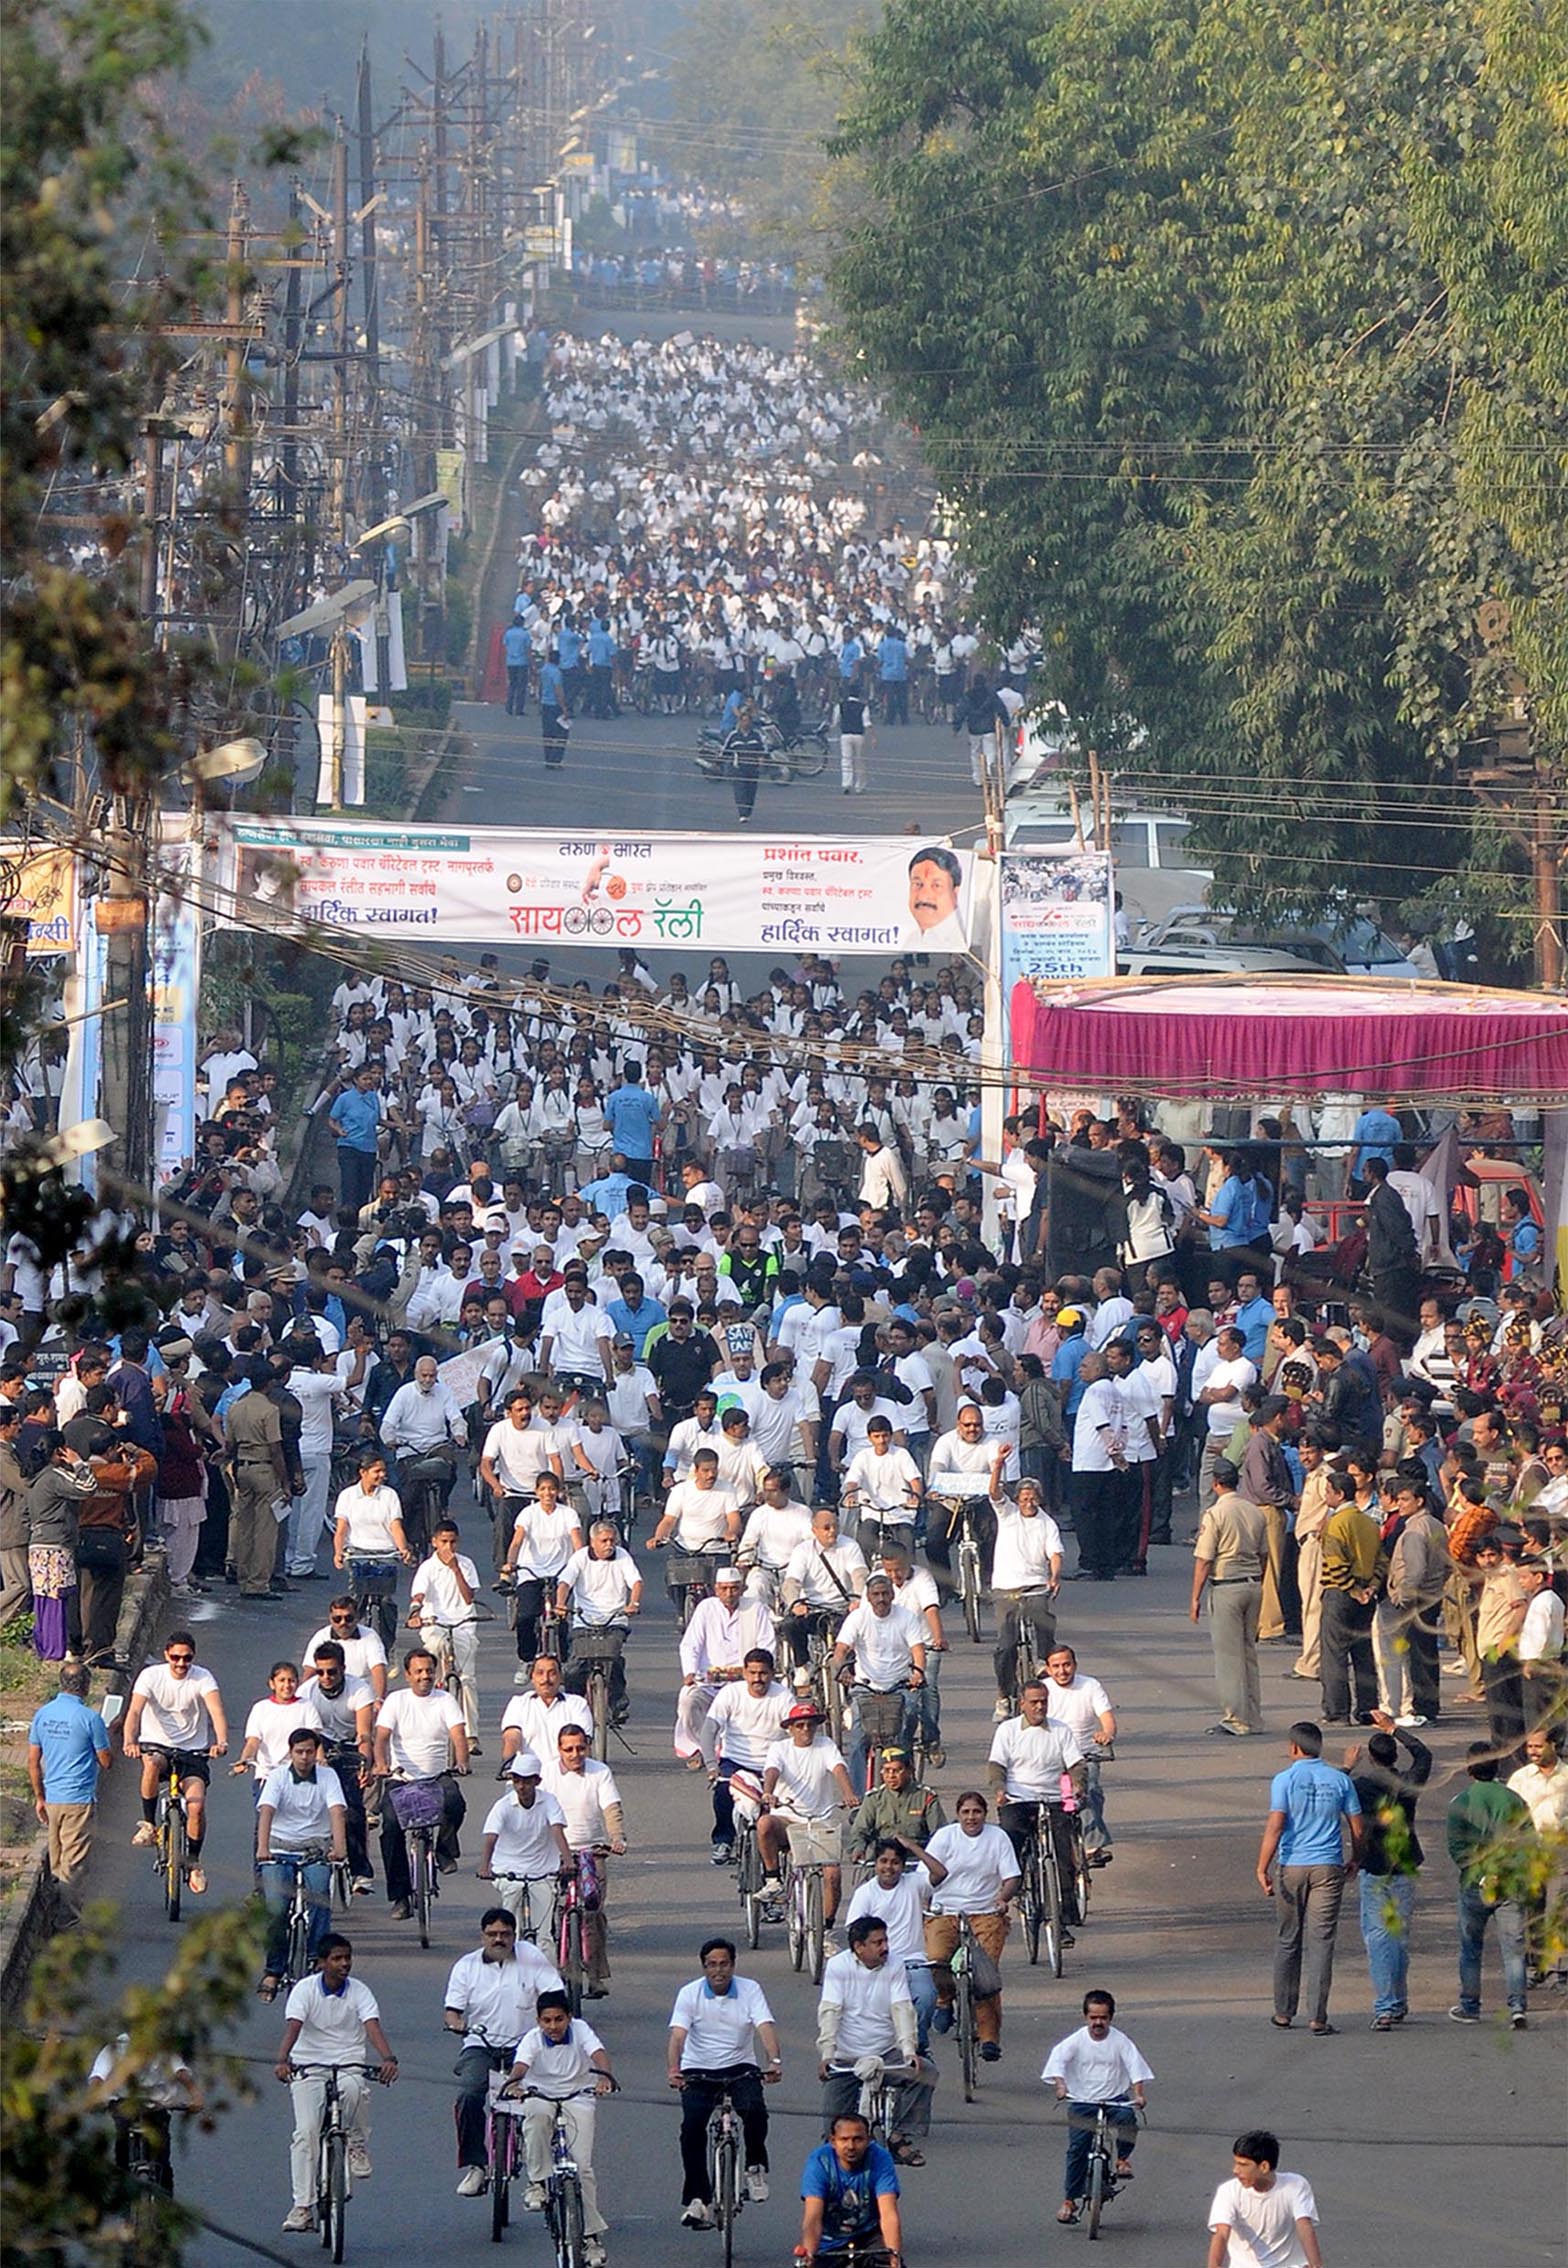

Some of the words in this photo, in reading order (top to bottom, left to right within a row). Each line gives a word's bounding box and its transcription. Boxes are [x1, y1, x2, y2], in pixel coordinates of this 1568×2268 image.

[559, 842, 596, 857] तरुण
[613, 843, 652, 858] भारत
[763, 844, 811, 863] प्रशांत
[299, 900, 358, 923] हार्दिक
[365, 907, 438, 925] स्वागत!
[653, 897, 704, 938] रॅली
[760, 918, 821, 944] हार्दिक
[827, 925, 900, 945] स्वागत!
[1029, 963, 1083, 974] 25th
